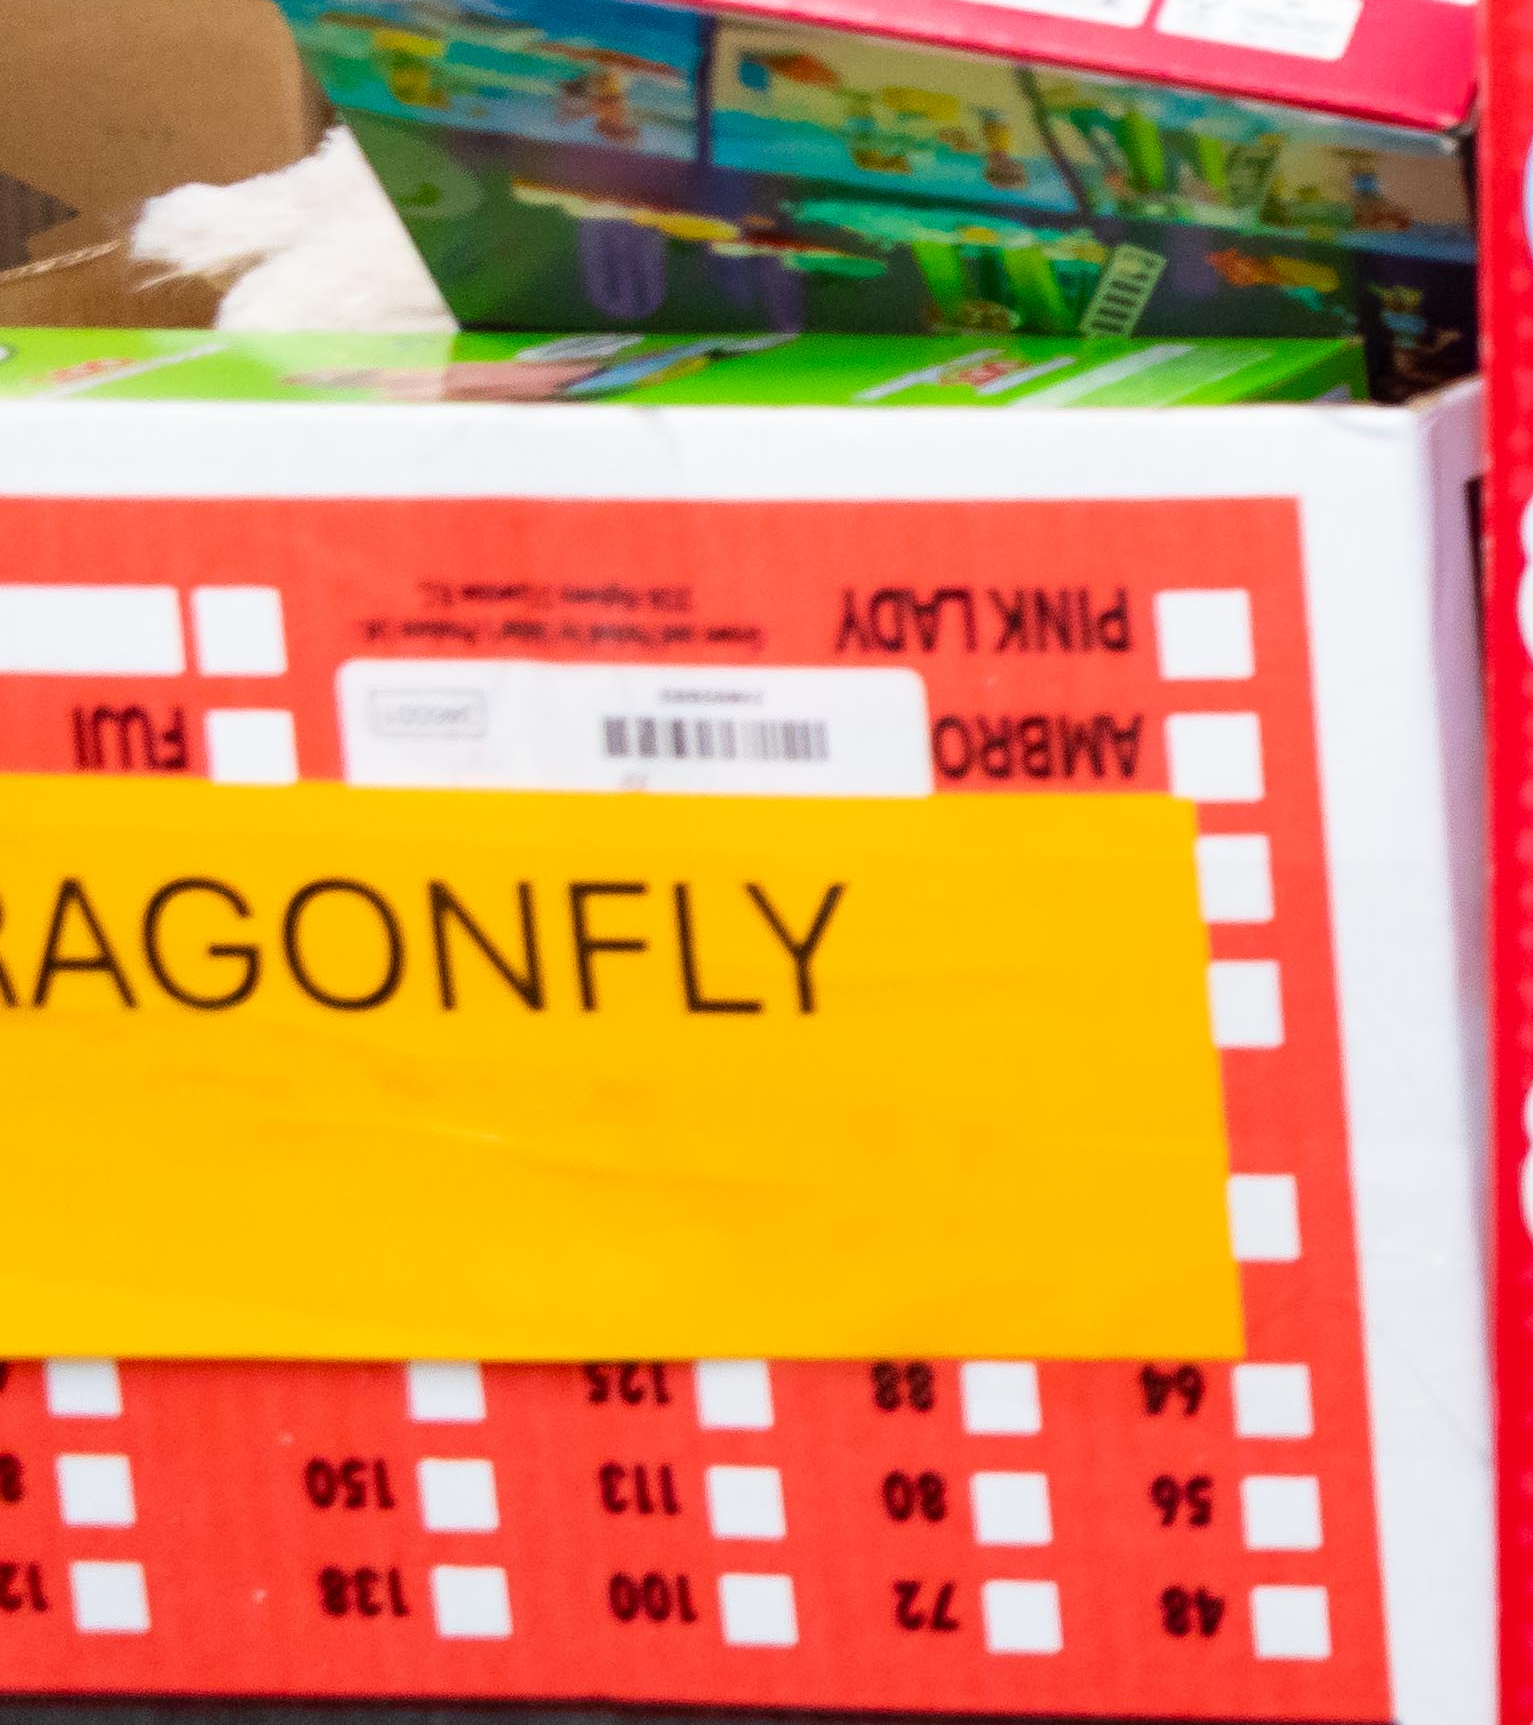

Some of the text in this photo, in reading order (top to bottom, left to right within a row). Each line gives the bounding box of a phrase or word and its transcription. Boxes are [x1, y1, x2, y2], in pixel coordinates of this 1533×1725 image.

[836, 586, 976, 654] LADY
[992, 586, 1130, 653] PINK
[71, 703, 190, 773] FUJI
[305, 1457, 396, 1509] 150
[599, 1463, 680, 1516] 113
[884, 1470, 947, 1523] 80
[1150, 1475, 1215, 1526] 56
[319, 1564, 411, 1619] 138
[609, 1572, 700, 1625] 100
[892, 1582, 960, 1634] 72
[1160, 1587, 1226, 1640] 48
